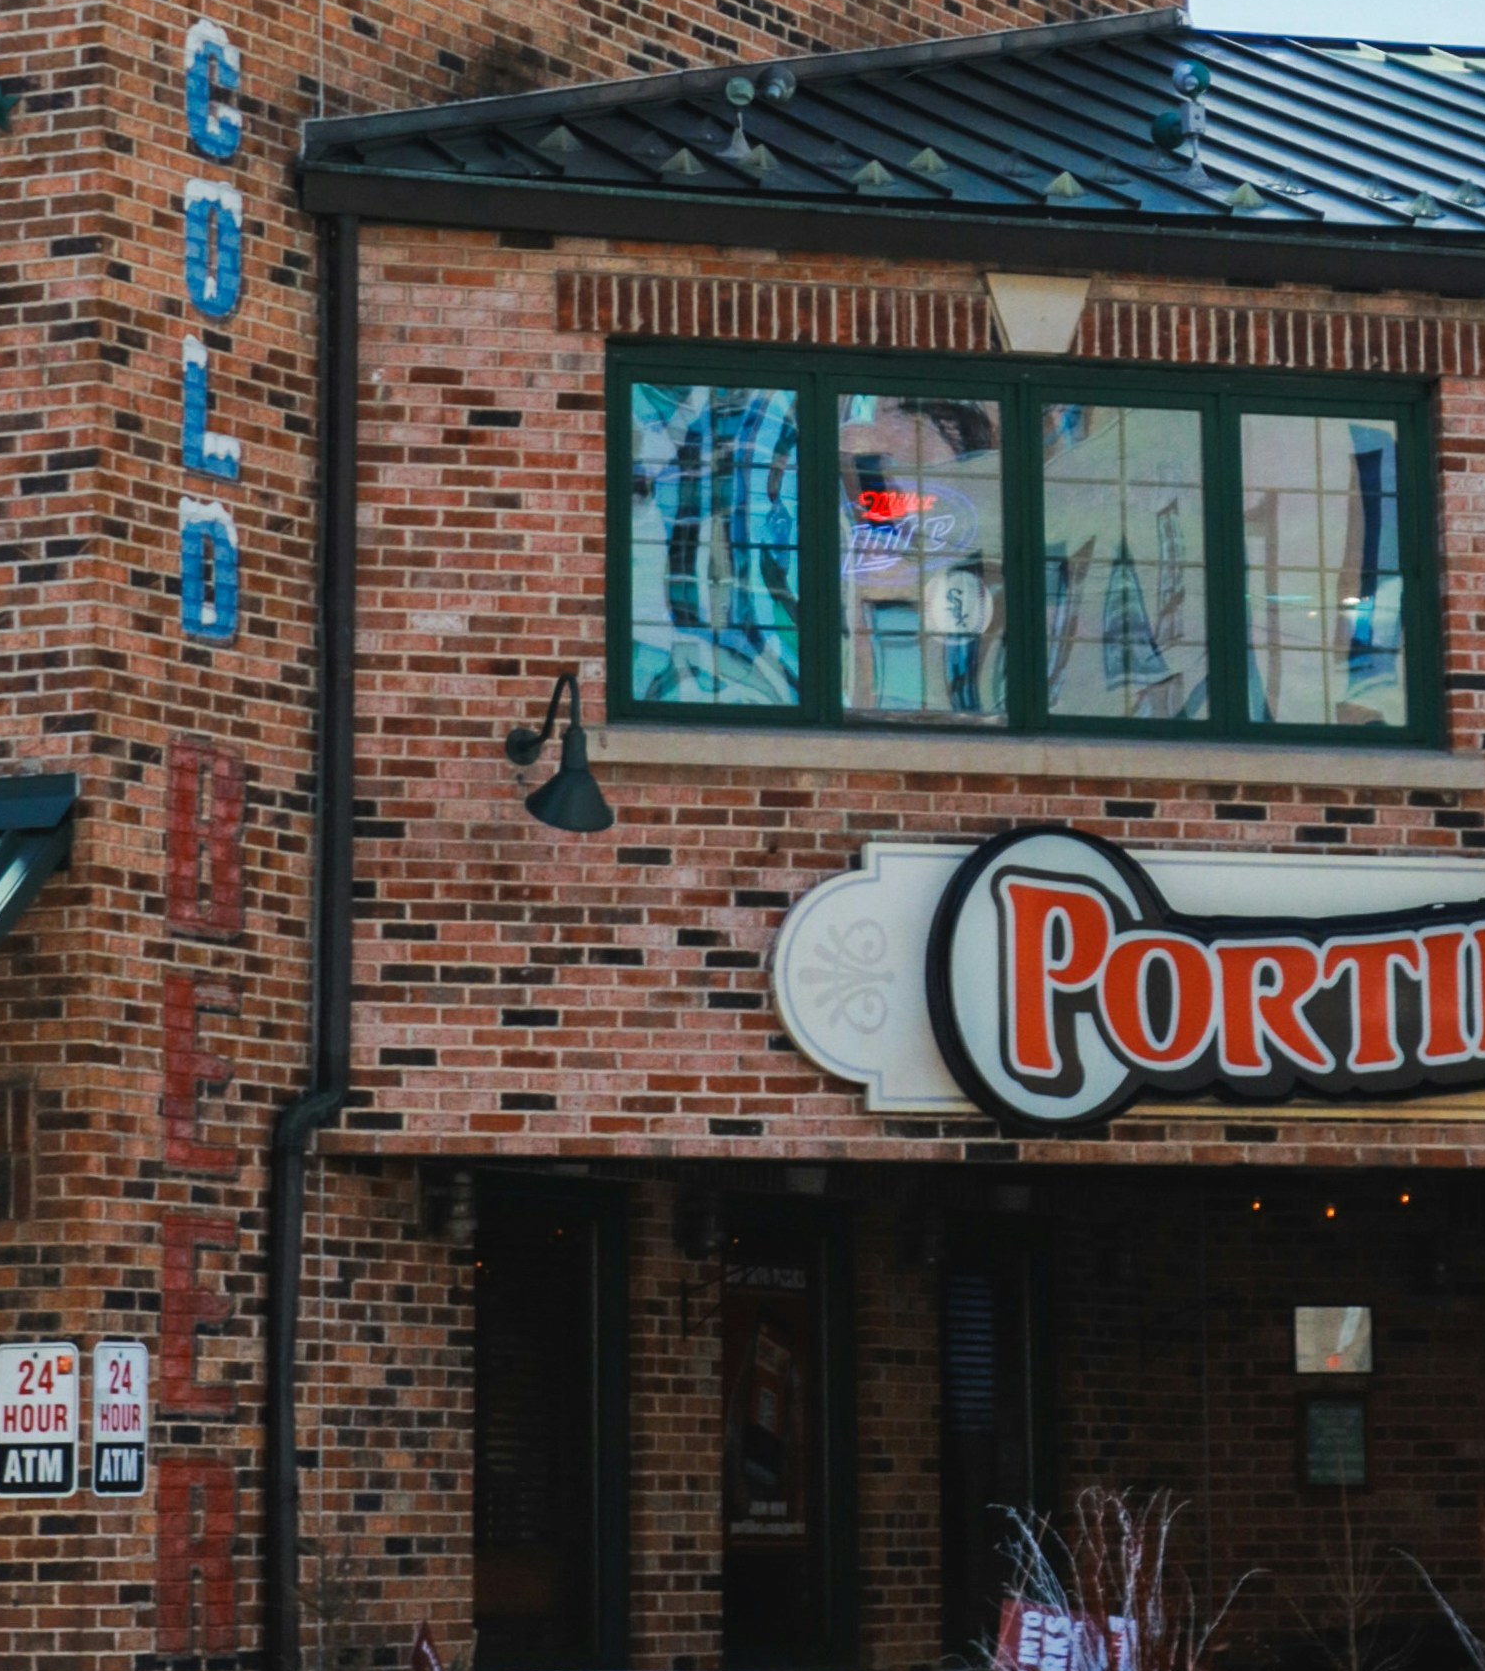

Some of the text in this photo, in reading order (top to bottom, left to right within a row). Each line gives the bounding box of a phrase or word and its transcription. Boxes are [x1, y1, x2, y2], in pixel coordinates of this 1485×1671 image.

[180, 17, 243, 643] COLD
[859, 490, 938, 522] Miller
[156, 735, 243, 1656] BEER
[18, 1359, 55, 1396] 24
[109, 1359, 132, 1395] 24
[2, 1403, 69, 1434] HOUR
[99, 1403, 141, 1433] HOUR
[3, 1448, 65, 1484] ATM
[99, 1448, 138, 1482] ATM
[1016, 1610, 1044, 1668] INTO
